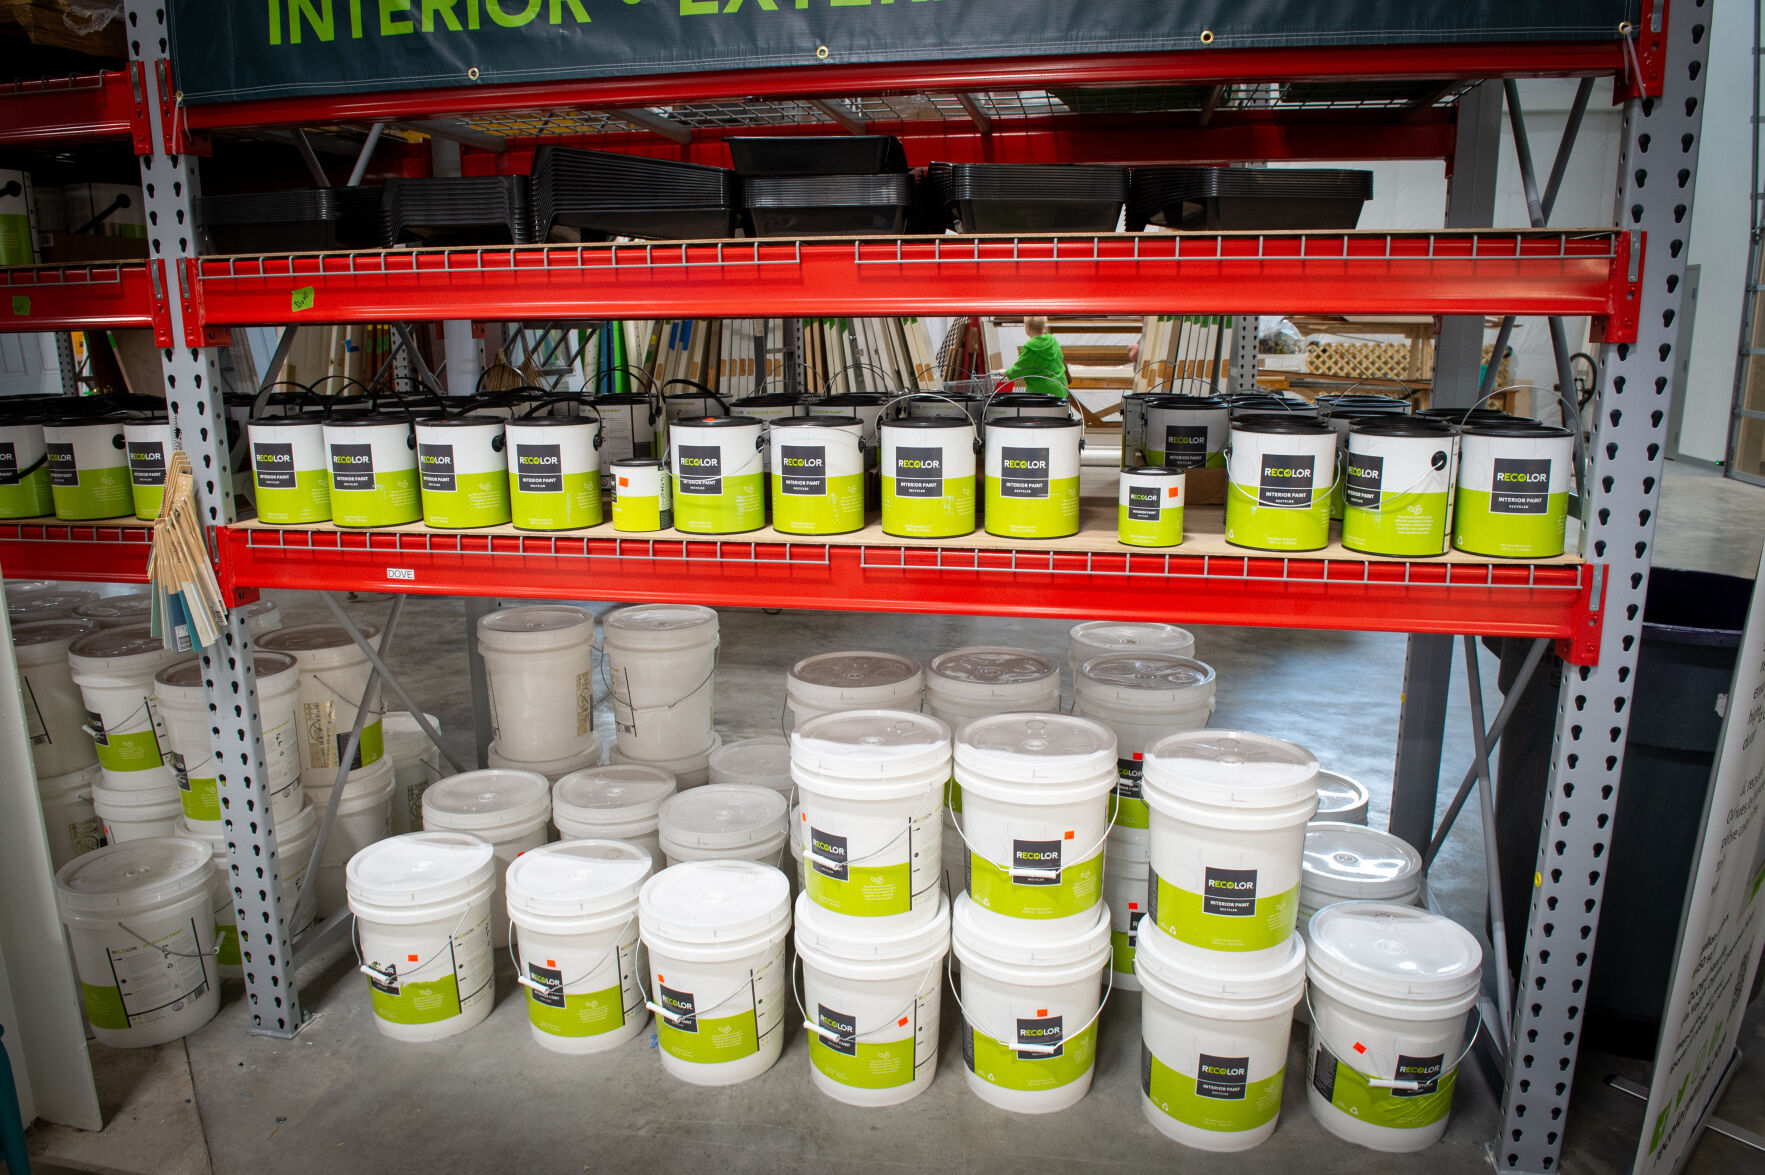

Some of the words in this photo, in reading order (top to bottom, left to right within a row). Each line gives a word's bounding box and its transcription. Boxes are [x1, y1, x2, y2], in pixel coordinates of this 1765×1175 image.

[256, 453, 290, 463] RECOLOR
[333, 454, 369, 464] RECOLOR
[420, 455, 452, 465] RECOLOR
[520, 456, 557, 466] RECOLOR
[680, 457, 718, 467] RECOLOR
[784, 457, 823, 467] RECOLOR
[898, 460, 940, 468] RECOLOR
[1004, 460, 1046, 469] RECOLOR
[1264, 468, 1311, 478] RECOLOR
[1496, 472, 1547, 482] RECOLOR
[1130, 493, 1157, 501] RECOLOR
[388, 570, 413, 579] DOVE
[1118, 768, 1143, 777] COLOR
[813, 838, 846, 855] RECOLOR
[1016, 851, 1058, 860] RECOLOR
[1208, 879, 1254, 890] RECOLOR
[531, 972, 560, 986] RECOLOR
[663, 995, 694, 1010] RECOLOR
[820, 1014, 854, 1032] RECOLOR
[1020, 1027, 1060, 1037] RECOLOR
[1202, 1064, 1246, 1076] RECOLOR
[1399, 1065, 1440, 1074] RECOLOR
